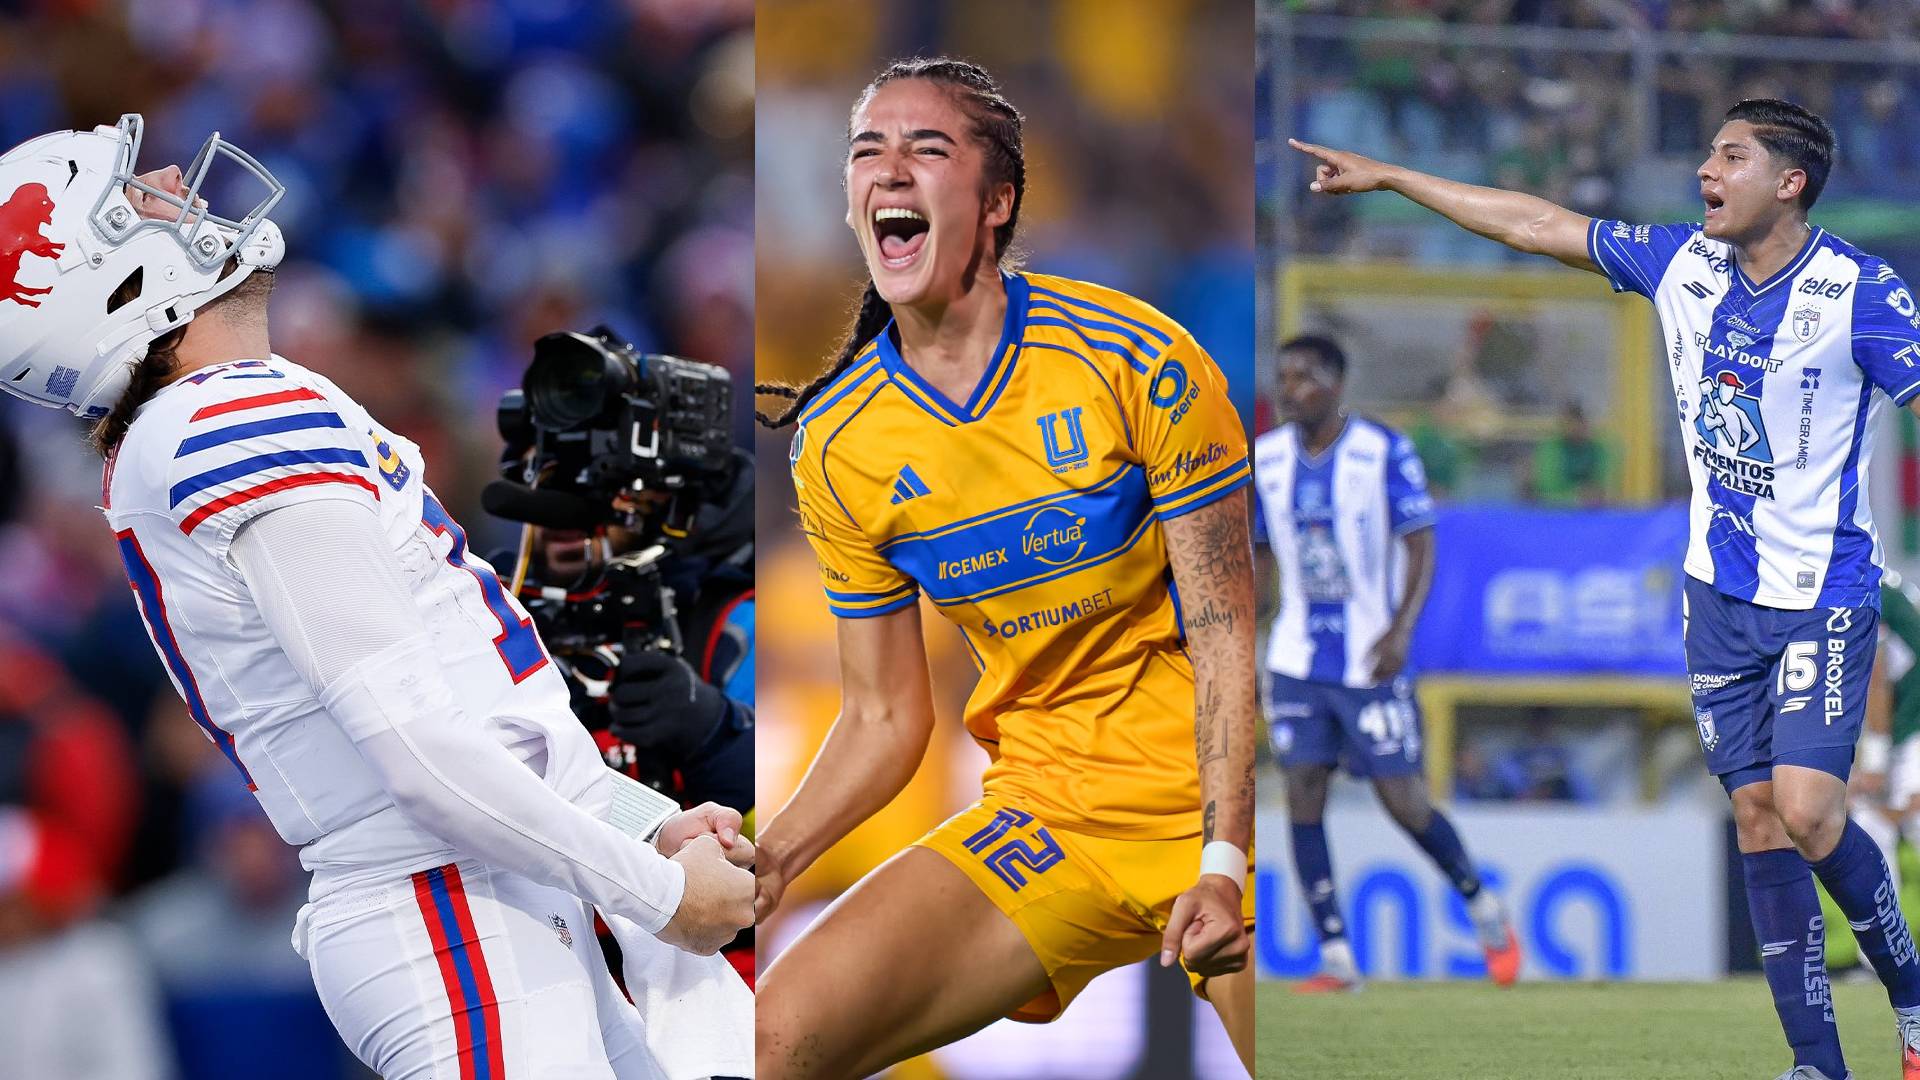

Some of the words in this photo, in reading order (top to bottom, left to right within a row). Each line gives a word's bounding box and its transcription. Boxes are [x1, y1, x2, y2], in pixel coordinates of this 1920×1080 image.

[1694, 331, 1784, 374] PLAYDOIT
[1169, 380, 1201, 425] Berel
[1802, 391, 1814, 415] TIME
[1796, 416, 1812, 471] CERAMICS
[947, 547, 1009, 580] CEMEX
[1022, 521, 1083, 557] Vertua
[1776, 640, 1819, 697] 15
[1824, 638, 1846, 726] BROXEL
[961, 806, 1066, 893] 12
[1873, 880, 1911, 968] ESTUCO
[1803, 915, 1826, 1006] ESTUCO
